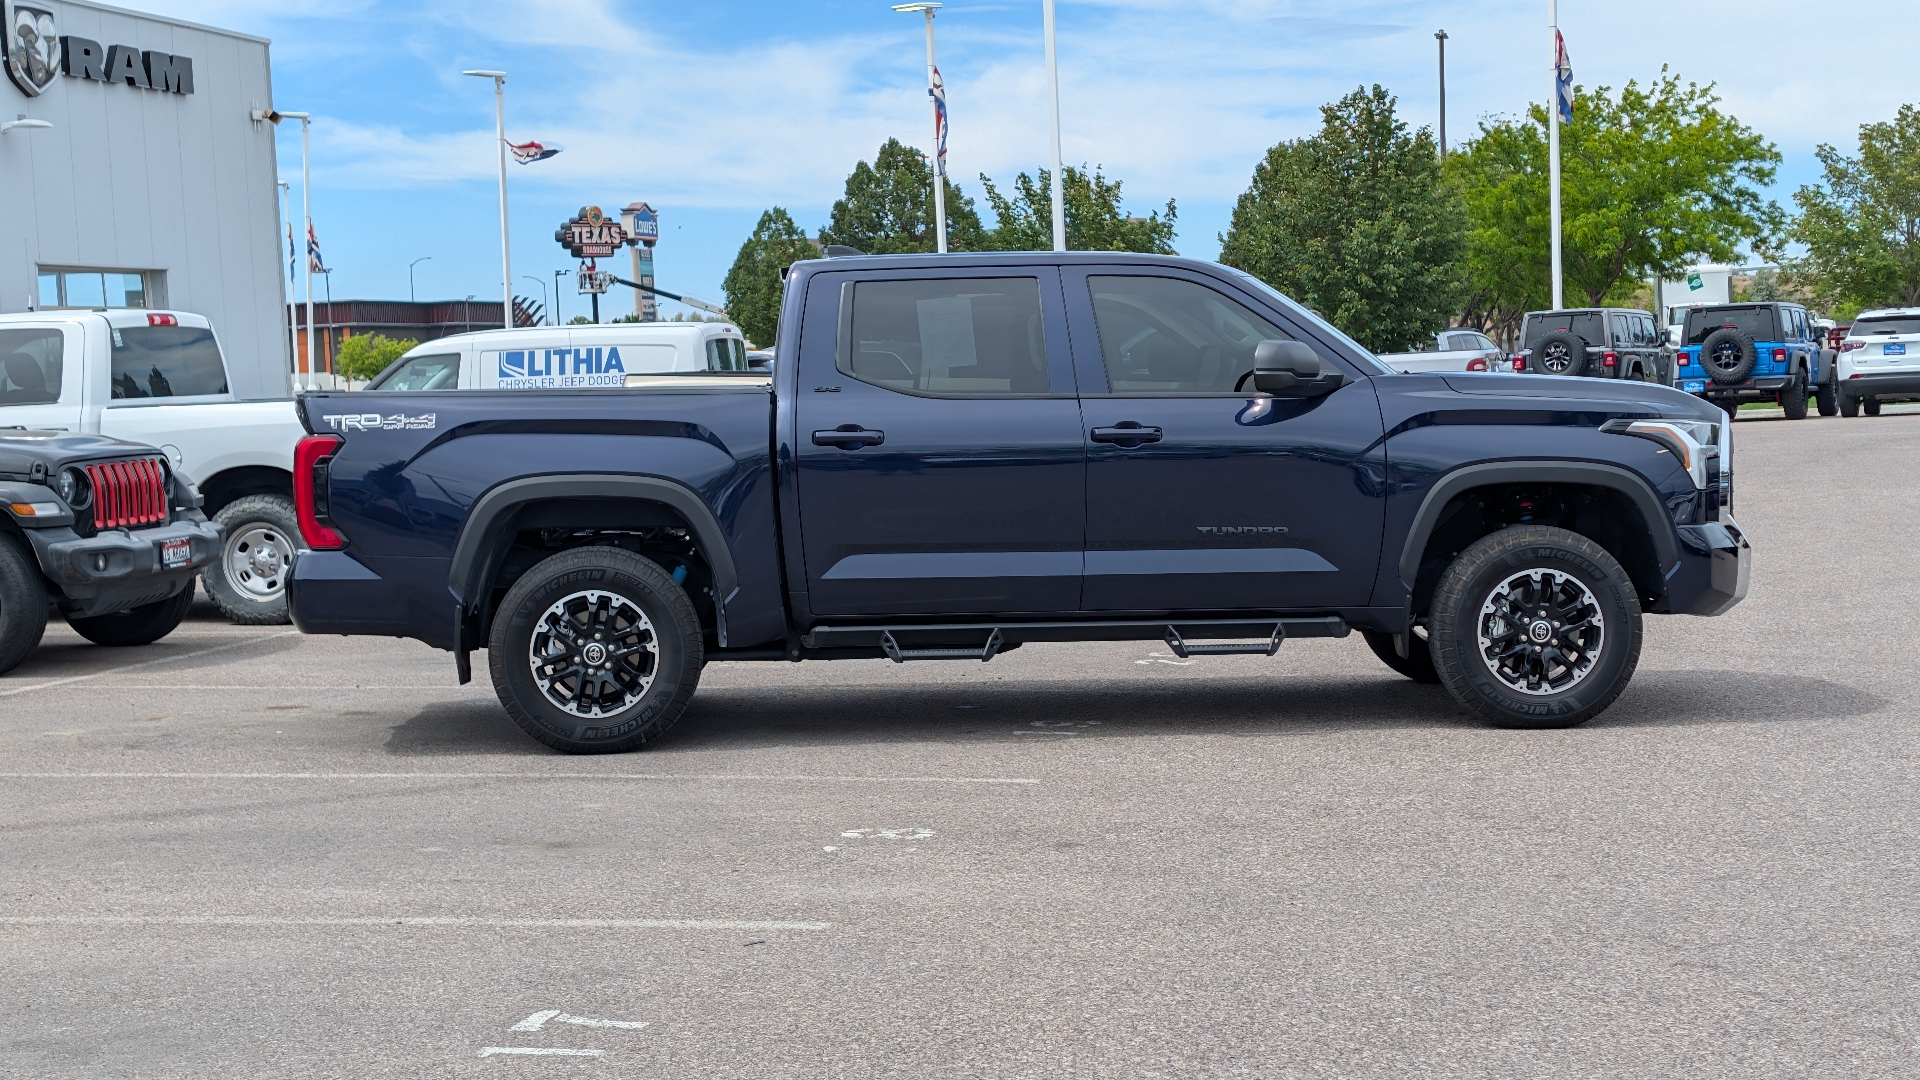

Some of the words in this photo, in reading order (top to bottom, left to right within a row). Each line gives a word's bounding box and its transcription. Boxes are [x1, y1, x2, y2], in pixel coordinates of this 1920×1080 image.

[59, 36, 194, 95] RAM
[571, 225, 621, 244] TEXAS
[635, 218, 657, 235] LOWE'S
[527, 347, 625, 377] LITHIA
[498, 377, 555, 389] CHRYSLER
[558, 376, 585, 387] JEEP
[588, 374, 626, 386] DODGE
[322, 413, 383, 432] TRD
[1196, 526, 1289, 536] TUNDRA
[1537, 548, 1604, 578] MICHELIN
[534, 570, 603, 600] MICHELIN
[1482, 684, 1548, 714] MICHELIN
[585, 707, 655, 738] MICHELIN
